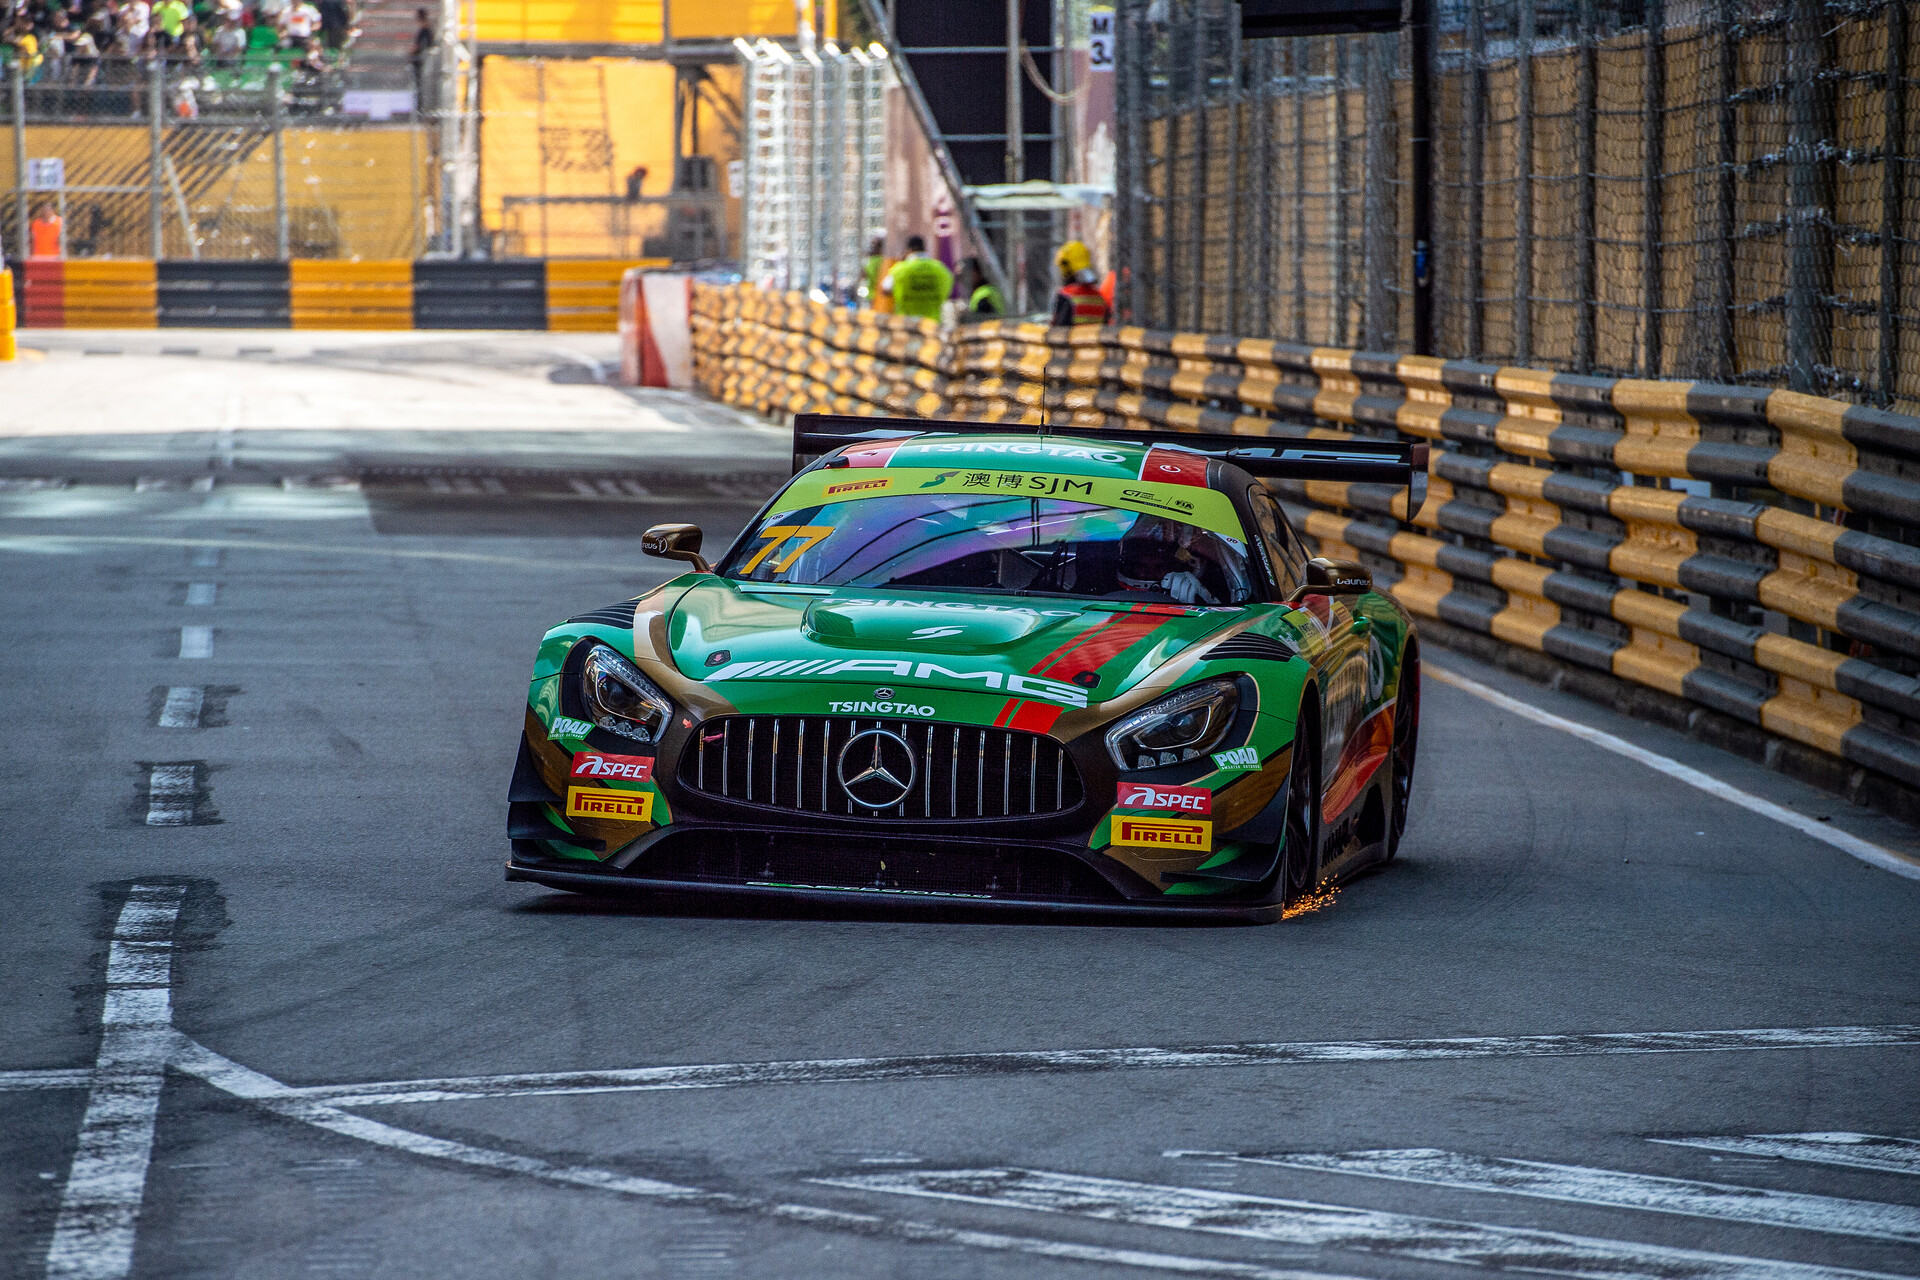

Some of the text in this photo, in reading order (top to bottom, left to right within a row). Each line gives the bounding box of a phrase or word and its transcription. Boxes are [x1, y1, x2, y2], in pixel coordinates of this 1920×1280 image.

[918, 443, 1127, 463] TSINGTAO
[828, 480, 888, 494] PIRELLI
[962, 472, 1093, 495] 澳博 SJM
[1176, 500, 1194, 510] FIA
[739, 525, 836, 575] 77
[820, 597, 1081, 617] TSINGTAO
[817, 658, 1088, 709] AMG
[828, 701, 936, 717] TSINGTAO
[550, 717, 592, 735] POAD
[1214, 747, 1258, 767] POAD
[574, 792, 645, 816] PIRELLI
[1121, 822, 1203, 845] PIRELLI
